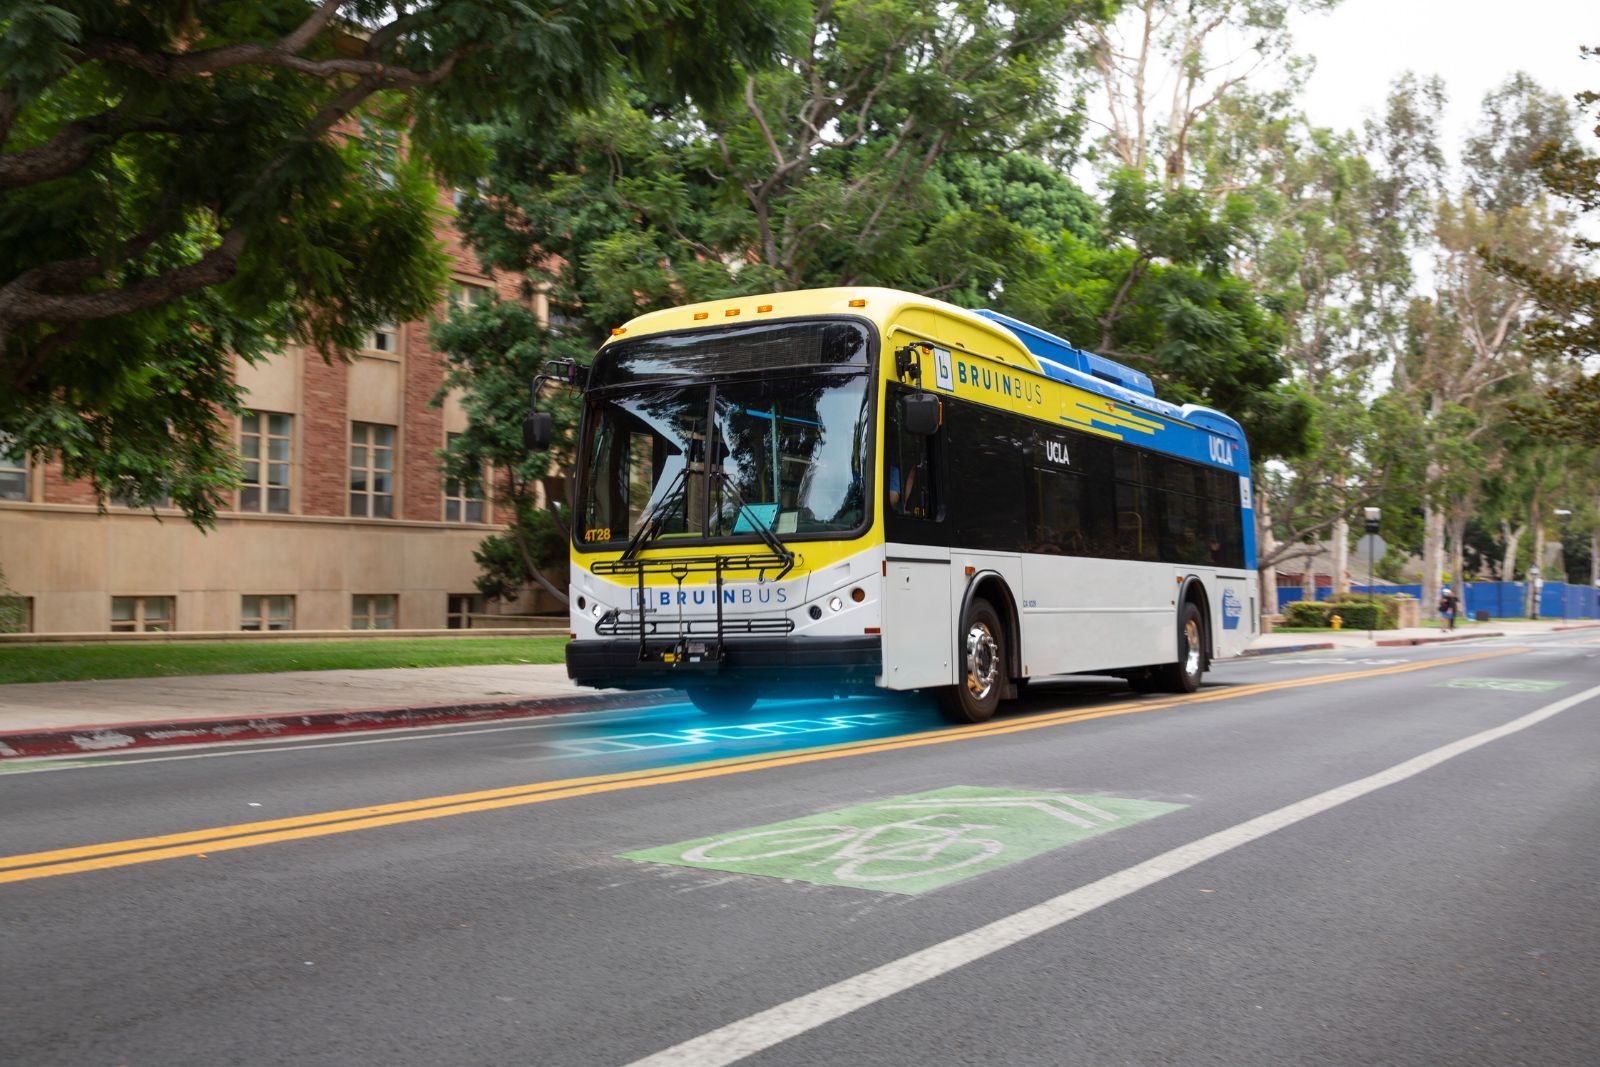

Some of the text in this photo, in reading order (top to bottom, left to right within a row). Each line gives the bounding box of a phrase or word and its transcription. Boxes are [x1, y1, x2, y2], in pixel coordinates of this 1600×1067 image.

[1046, 440, 1070, 465] UCLA
[1209, 434, 1233, 467] UCLA
[584, 528, 611, 542] 4T28
